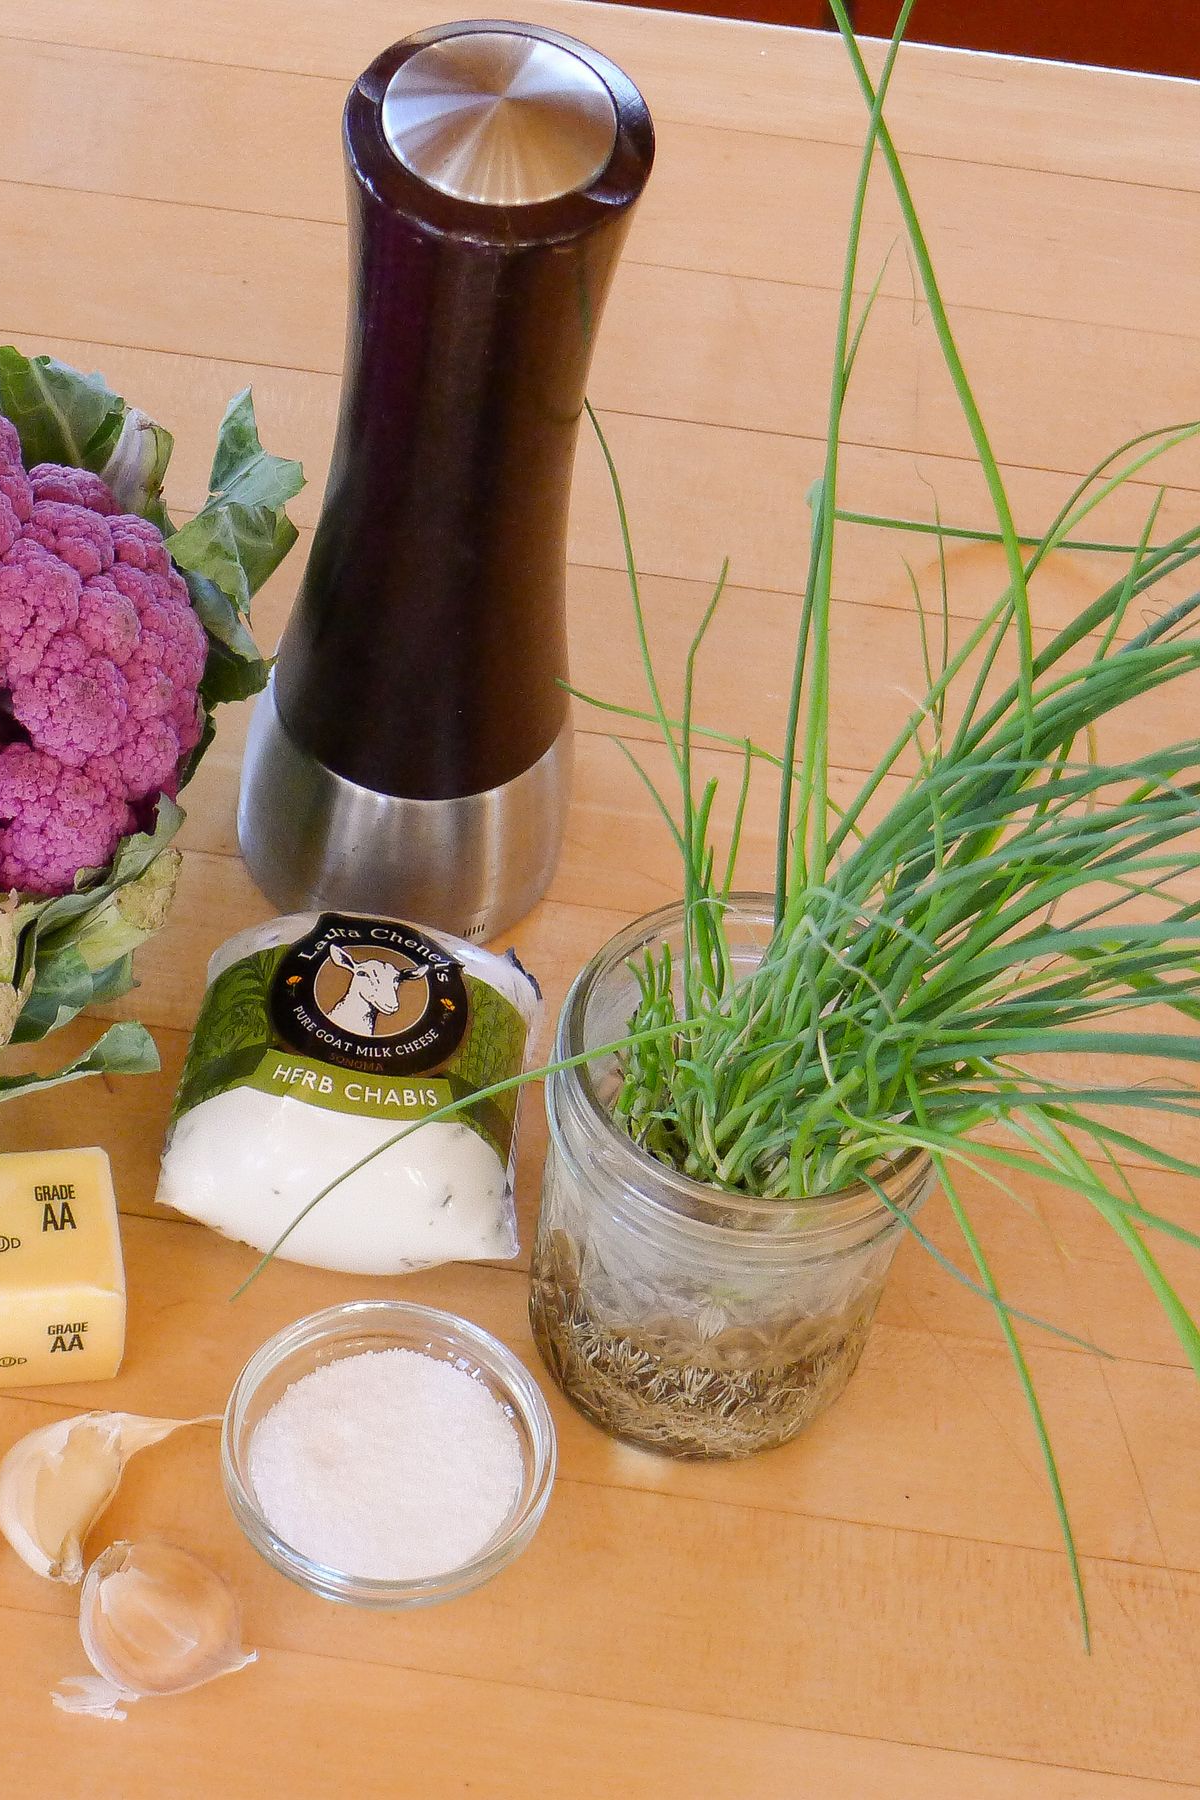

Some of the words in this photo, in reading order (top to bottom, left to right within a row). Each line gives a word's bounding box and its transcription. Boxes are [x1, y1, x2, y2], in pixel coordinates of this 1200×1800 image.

[292, 1005, 317, 1032] PURE
[315, 1029, 353, 1052] GOAT
[355, 1045, 392, 1058] MILK
[395, 1028, 439, 1056] CHEESE
[329, 1052, 384, 1072] SONOMA
[272, 1064, 334, 1094] HERB
[344, 1083, 438, 1107] CHABIS
[34, 1184, 76, 1202] GRADE
[42, 1201, 77, 1232] AA
[47, 1321, 89, 1336] GRADE
[50, 1334, 84, 1353] AA
